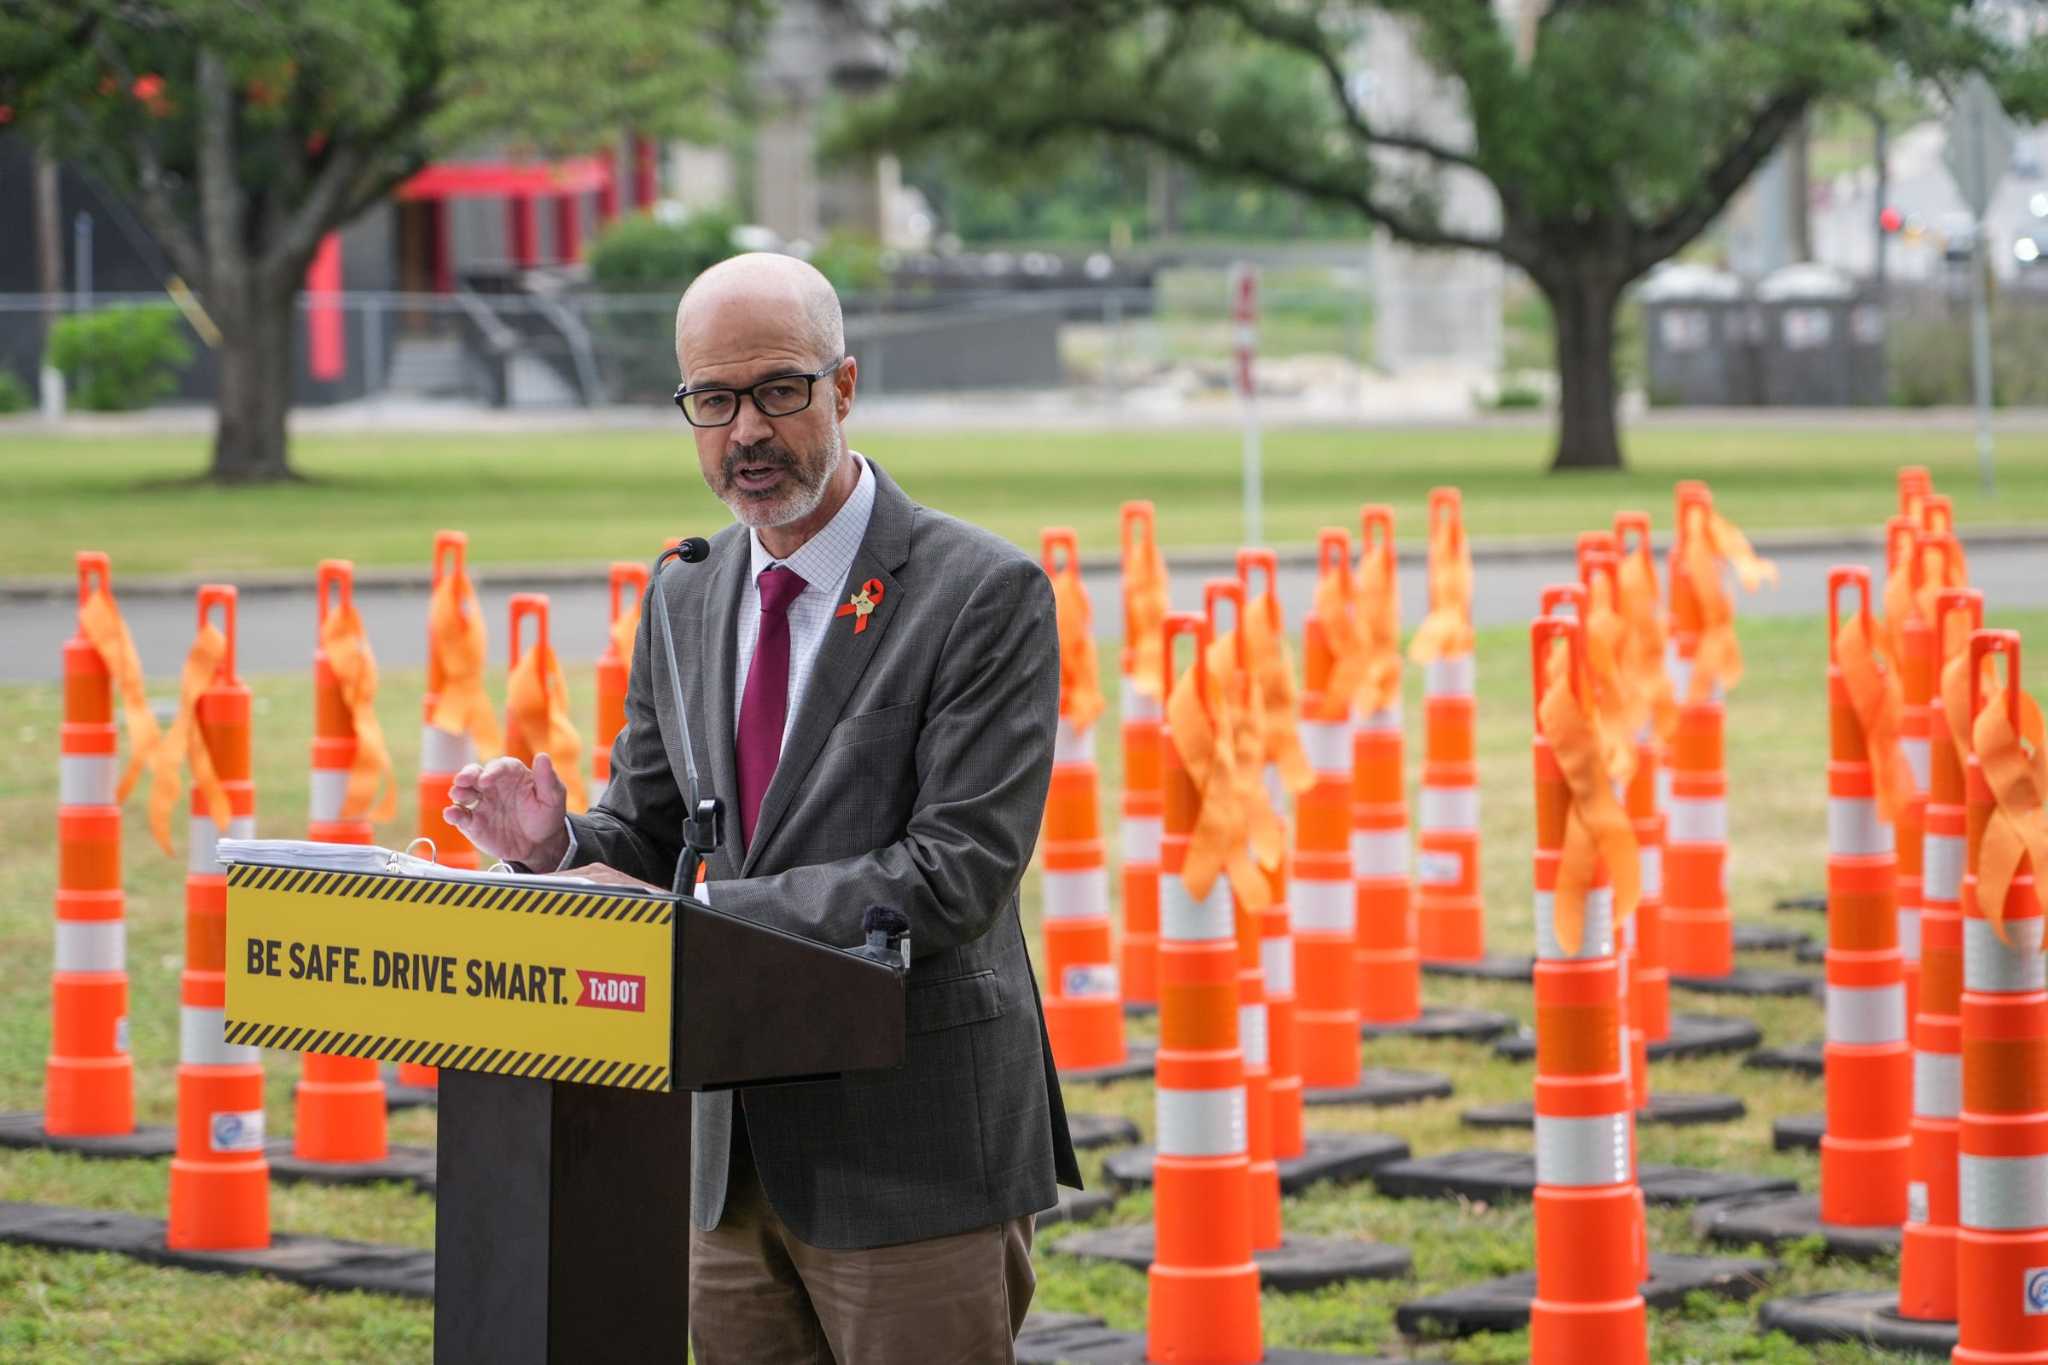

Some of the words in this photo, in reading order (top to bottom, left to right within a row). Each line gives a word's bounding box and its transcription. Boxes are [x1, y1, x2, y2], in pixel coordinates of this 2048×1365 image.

[247, 938, 282, 976] BE
[289, 942, 367, 985] SAFE.
[373, 950, 457, 994] DRIVE
[466, 959, 569, 1005] SMART.
[589, 978, 639, 1004] TxDOT
